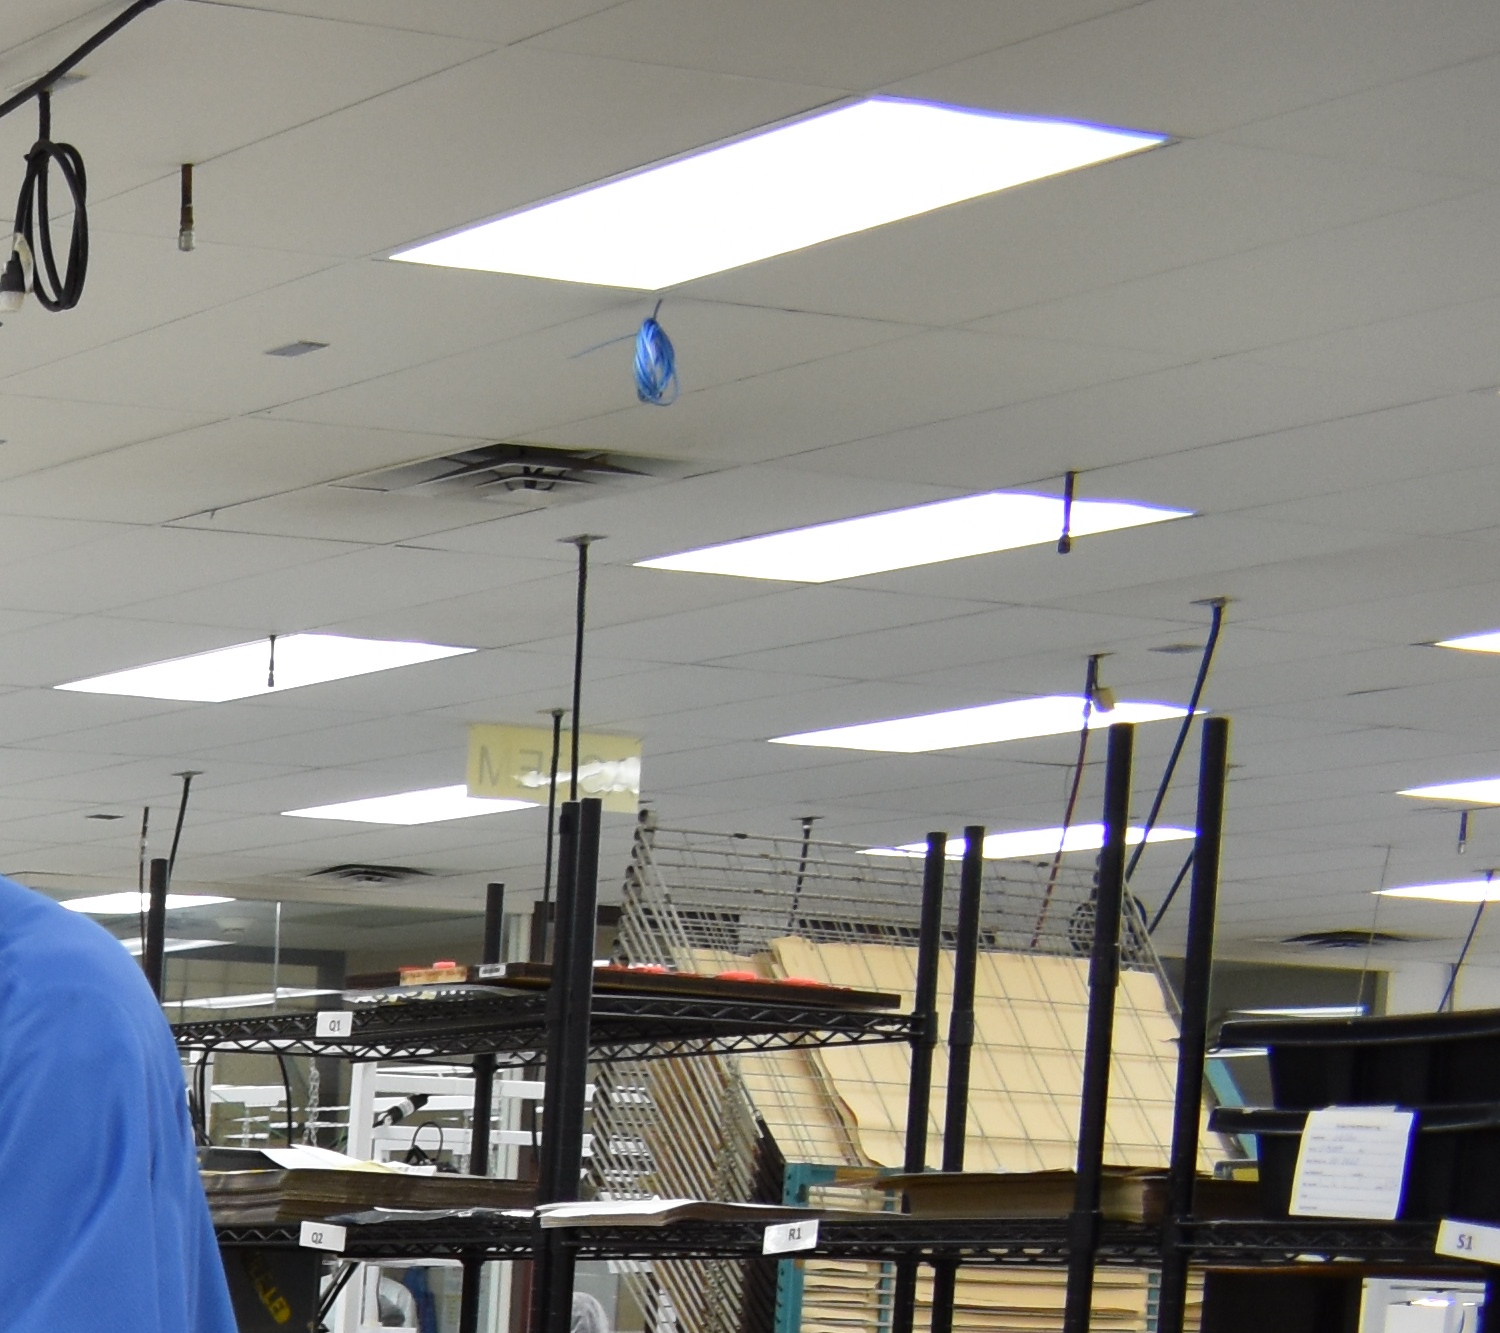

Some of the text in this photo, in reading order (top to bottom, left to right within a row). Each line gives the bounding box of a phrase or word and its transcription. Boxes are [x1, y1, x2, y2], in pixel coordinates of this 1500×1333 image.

[328, 1019, 341, 1033] Q1
[311, 1232, 323, 1244] Q2
[787, 1227, 802, 1242] R1
[1456, 1234, 1473, 1250] S1
